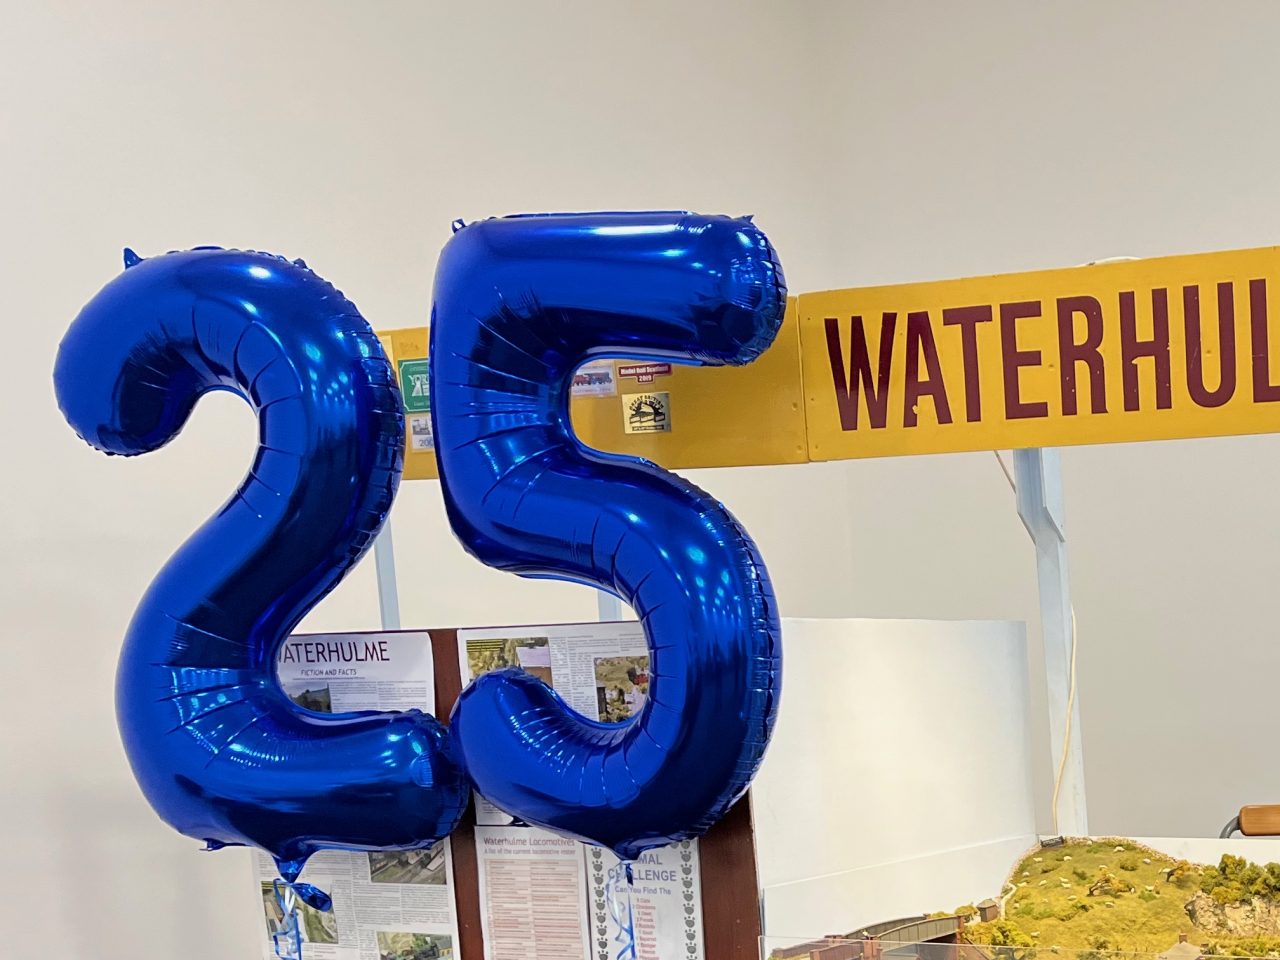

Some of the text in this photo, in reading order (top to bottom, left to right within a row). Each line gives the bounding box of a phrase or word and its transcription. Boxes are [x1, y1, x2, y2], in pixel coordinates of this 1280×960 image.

[278, 641, 391, 664] ATERHULME
[300, 669, 324, 677] FICTION
[338, 668, 357, 676] FACTS
[643, 886, 658, 895] Find
[659, 887, 672, 895] The
